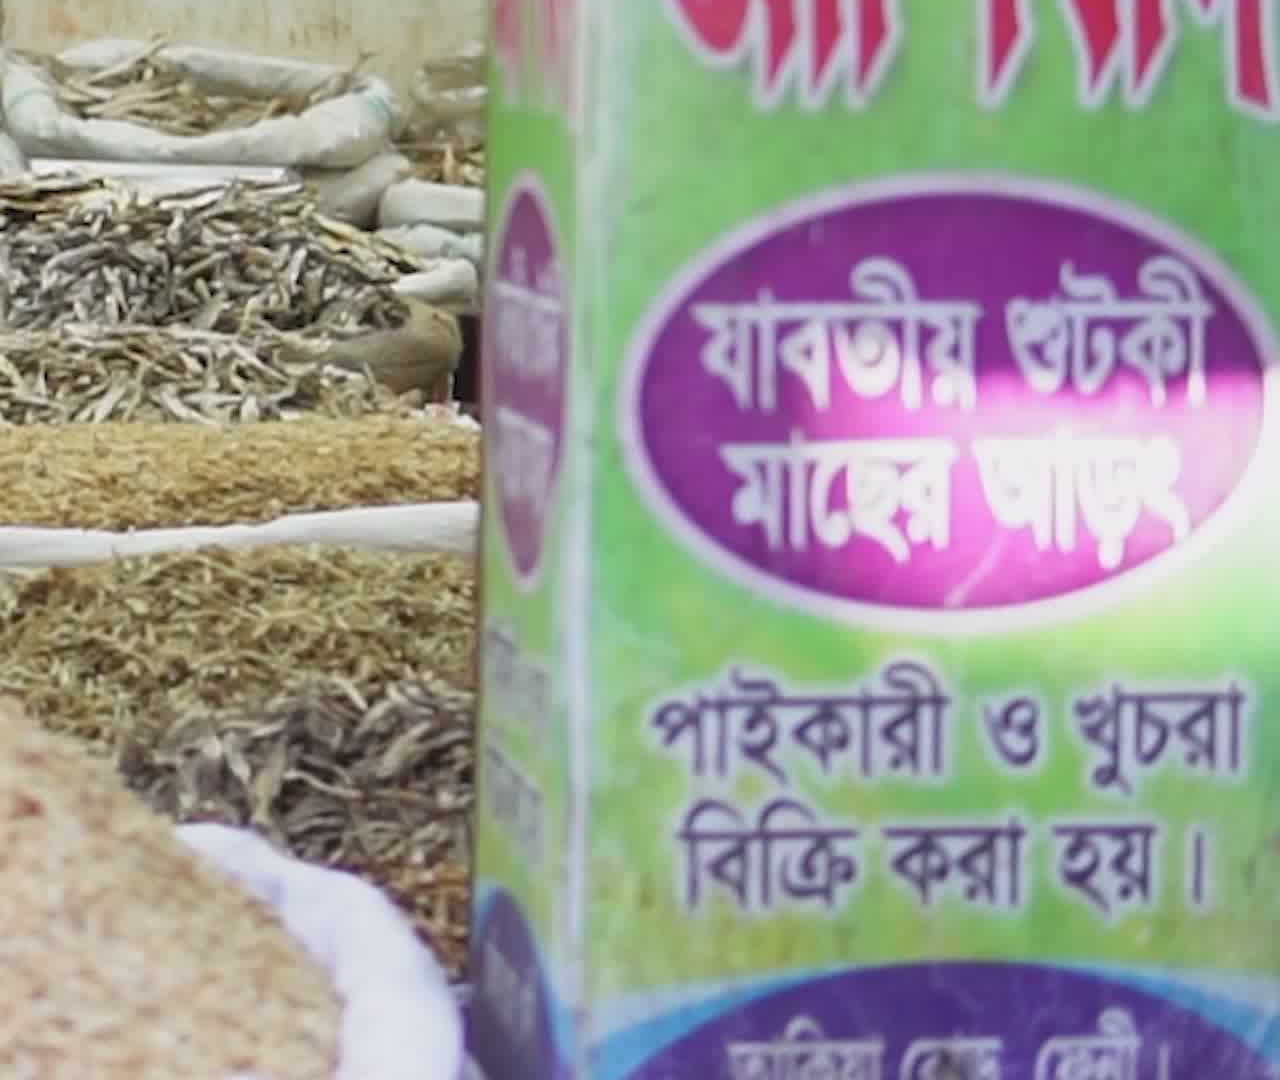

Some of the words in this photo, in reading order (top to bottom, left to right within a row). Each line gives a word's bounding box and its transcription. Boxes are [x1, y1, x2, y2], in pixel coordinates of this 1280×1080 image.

[692, 257, 983, 413] যাবতীয়
[1005, 257, 1214, 408] শুটকী
[721, 427, 956, 566] মাছের
[975, 430, 1192, 572] আড়ৎ
[650, 662, 949, 782] পাইকারী
[983, 696, 1042, 769] ও
[1073, 682, 1246, 793] খুচরা
[678, 798, 858, 909] বিক্রি
[885, 817, 1026, 906] করা
[1052, 821, 1156, 909] হয়
